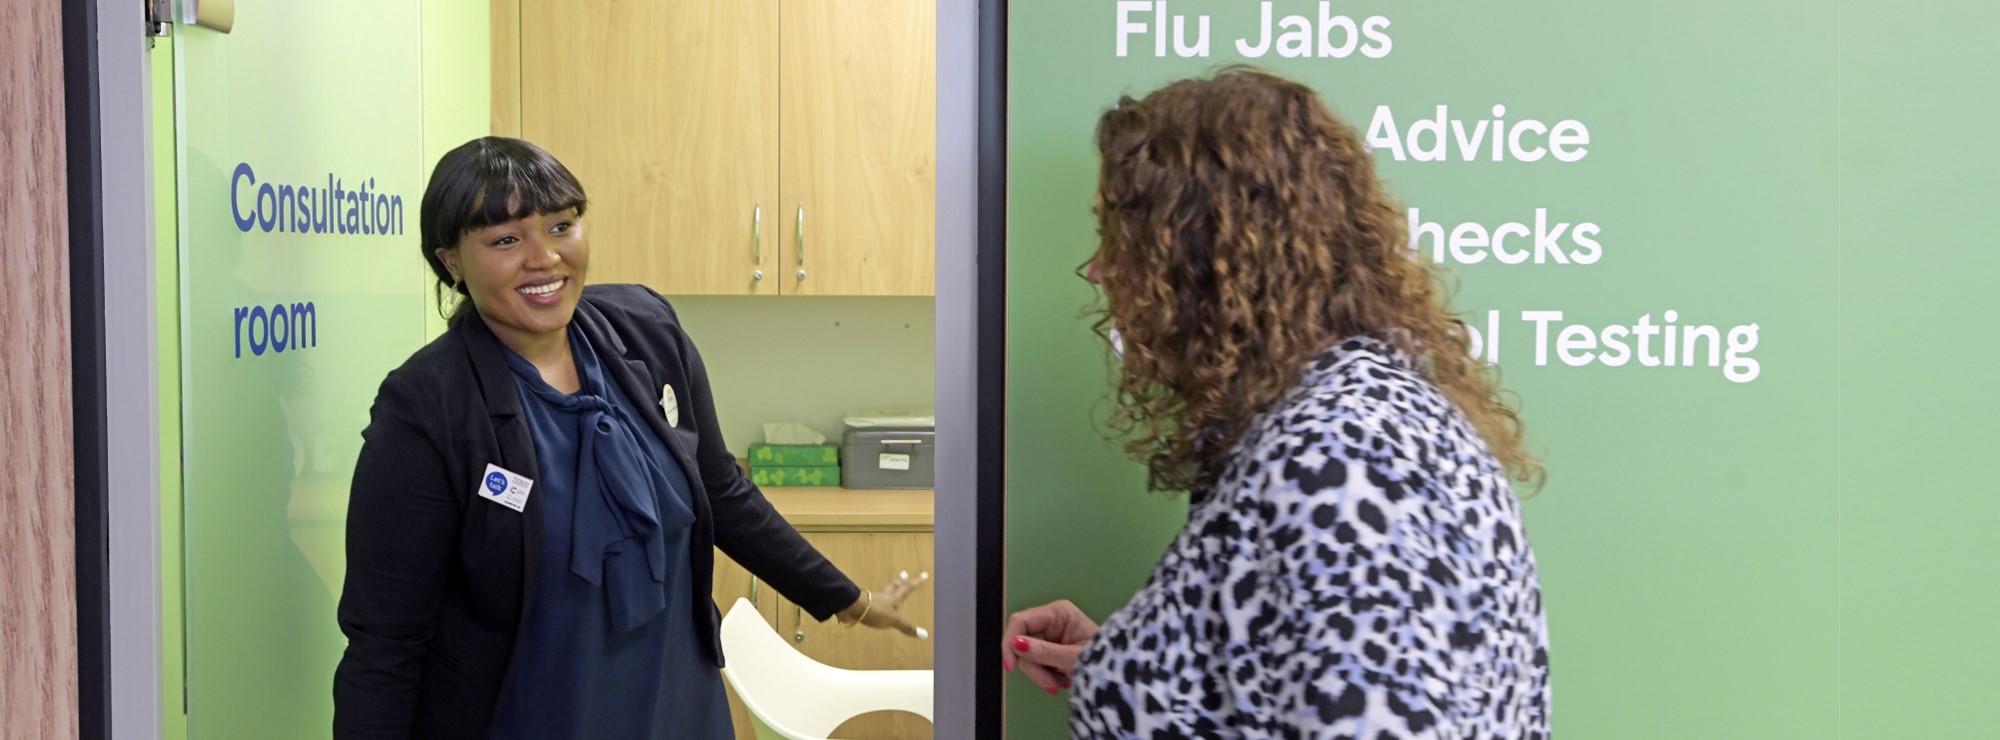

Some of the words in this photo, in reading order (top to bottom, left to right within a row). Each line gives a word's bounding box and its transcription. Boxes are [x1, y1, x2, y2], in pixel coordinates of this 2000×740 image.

[1116, 0, 1210, 58] Flu
[1235, 0, 1393, 59] Jabs
[1363, 104, 1590, 162] Advice
[231, 162, 404, 235] Consultation
[1407, 207, 1603, 265] hecks
[234, 301, 317, 359] room
[1521, 309, 1761, 383] Testing
